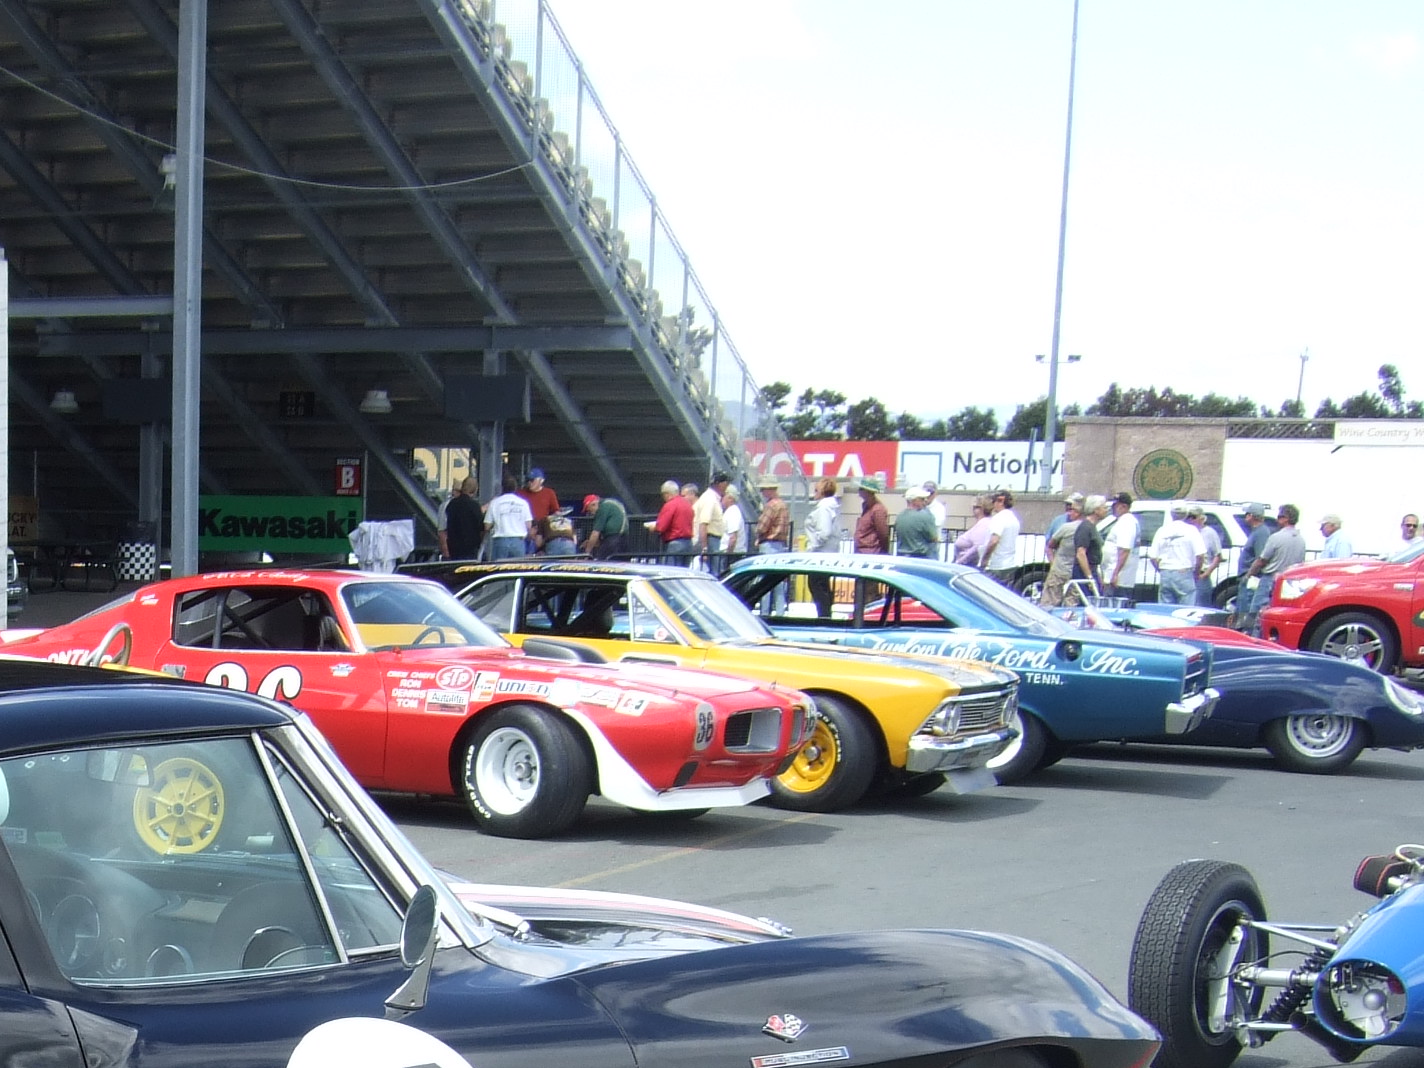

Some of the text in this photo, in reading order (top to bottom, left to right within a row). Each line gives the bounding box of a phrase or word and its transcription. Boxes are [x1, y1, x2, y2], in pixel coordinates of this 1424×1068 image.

[342, 467, 355, 489] B
[199, 508, 357, 539] Kawasaki
[1081, 649, 1140, 676] Inc.
[399, 679, 422, 688] RON
[441, 668, 470, 687] STP
[397, 699, 419, 708] TOM
[696, 711, 714, 744] 36
